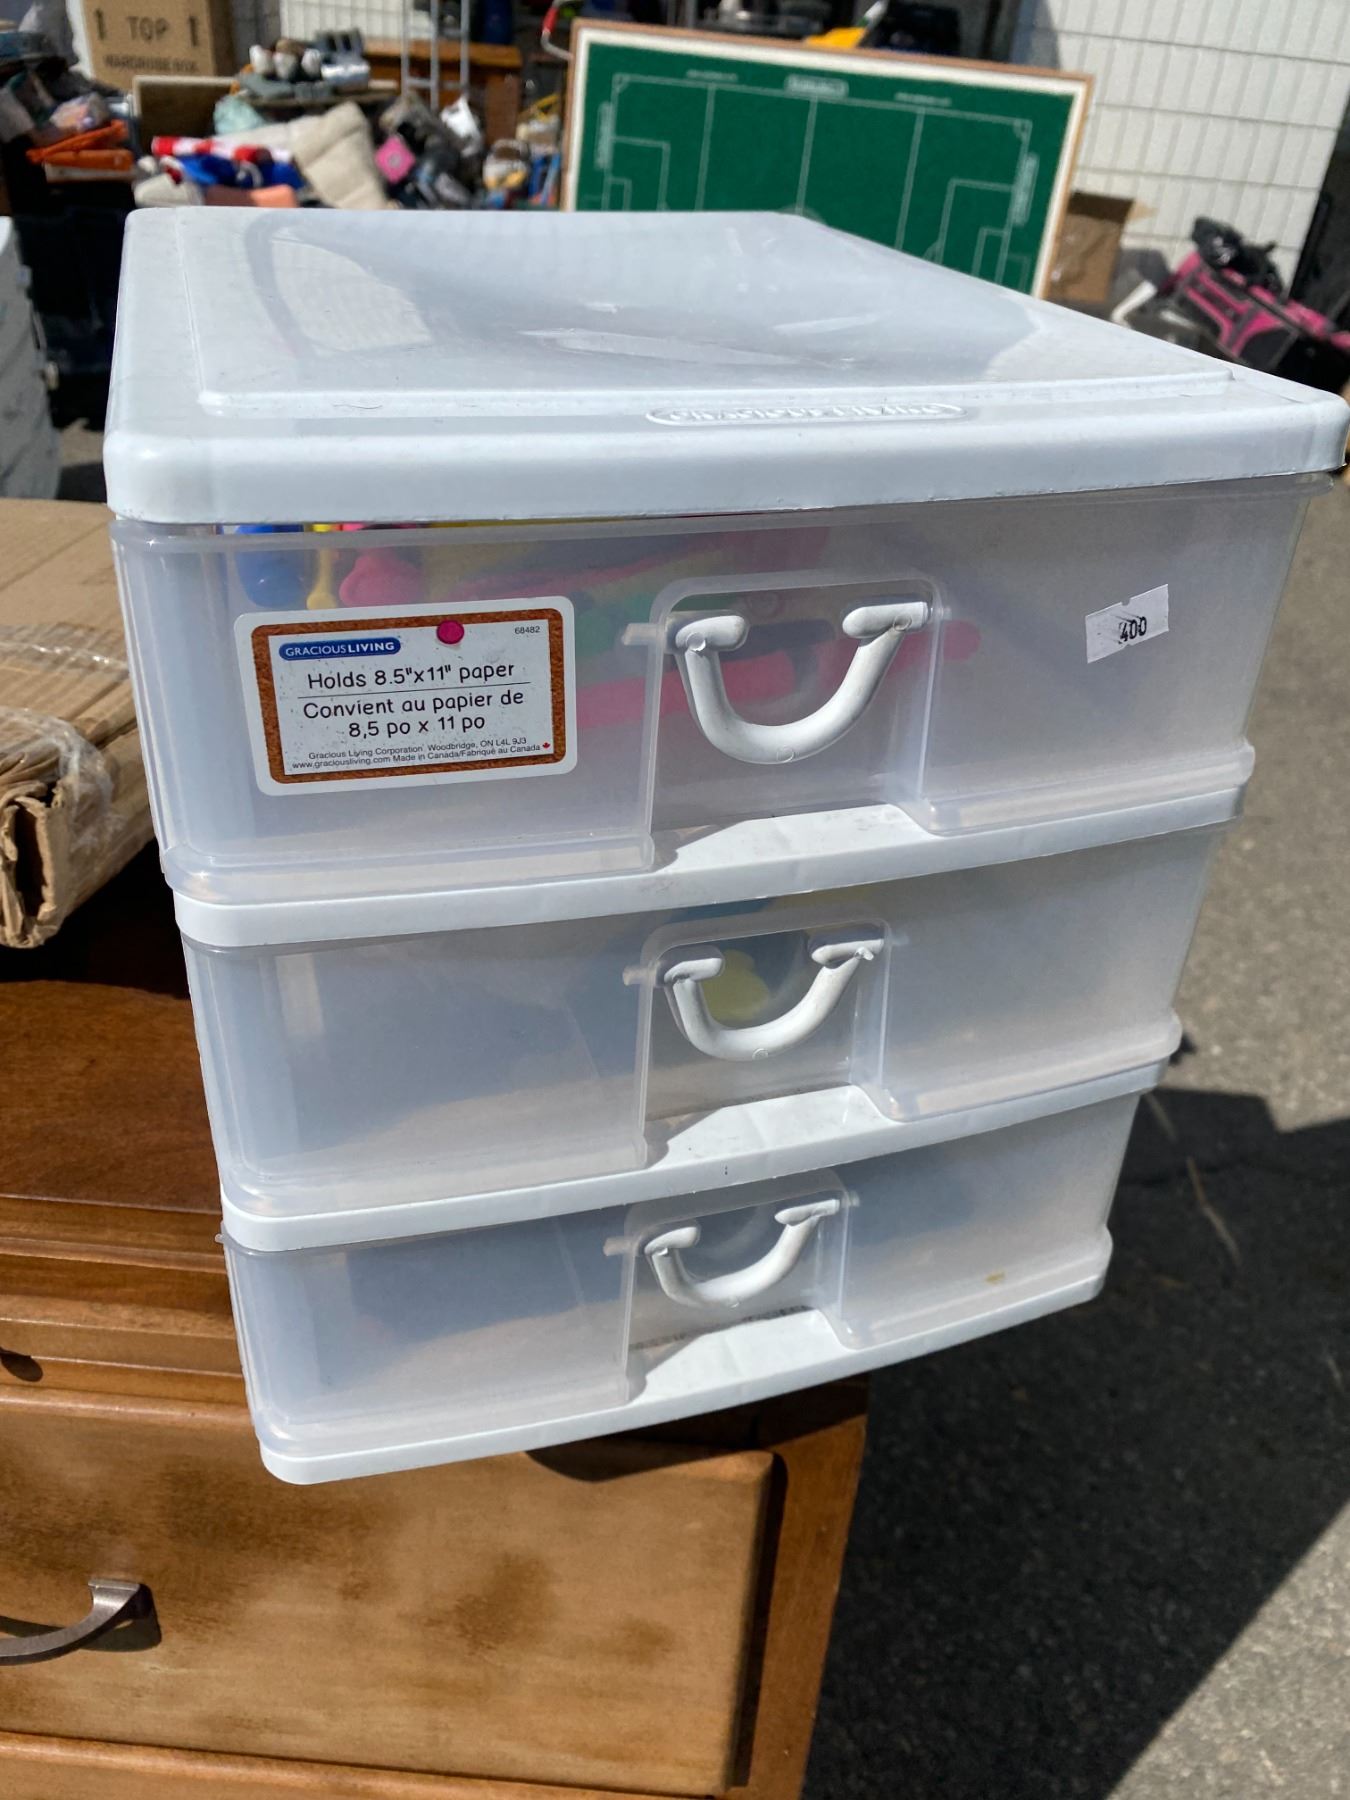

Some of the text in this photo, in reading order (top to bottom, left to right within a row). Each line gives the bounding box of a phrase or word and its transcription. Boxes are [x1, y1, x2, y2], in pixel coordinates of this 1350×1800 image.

[125, 16, 169, 41] TOP
[514, 625, 541, 635] 68482
[308, 664, 515, 689] Holds 8.5"x11" paper
[303, 689, 524, 719] Convient au papier de
[349, 716, 485, 739] 8,5 po x 11 po
[293, 756, 391, 769] www.graciousliving.com
[418, 752, 426, 761] in
[510, 744, 541, 753] Canada
[308, 752, 346, 760] Gracious
[349, 749, 373, 757] Living
[480, 740, 494, 748] ON
[496, 738, 511, 746] L4L
